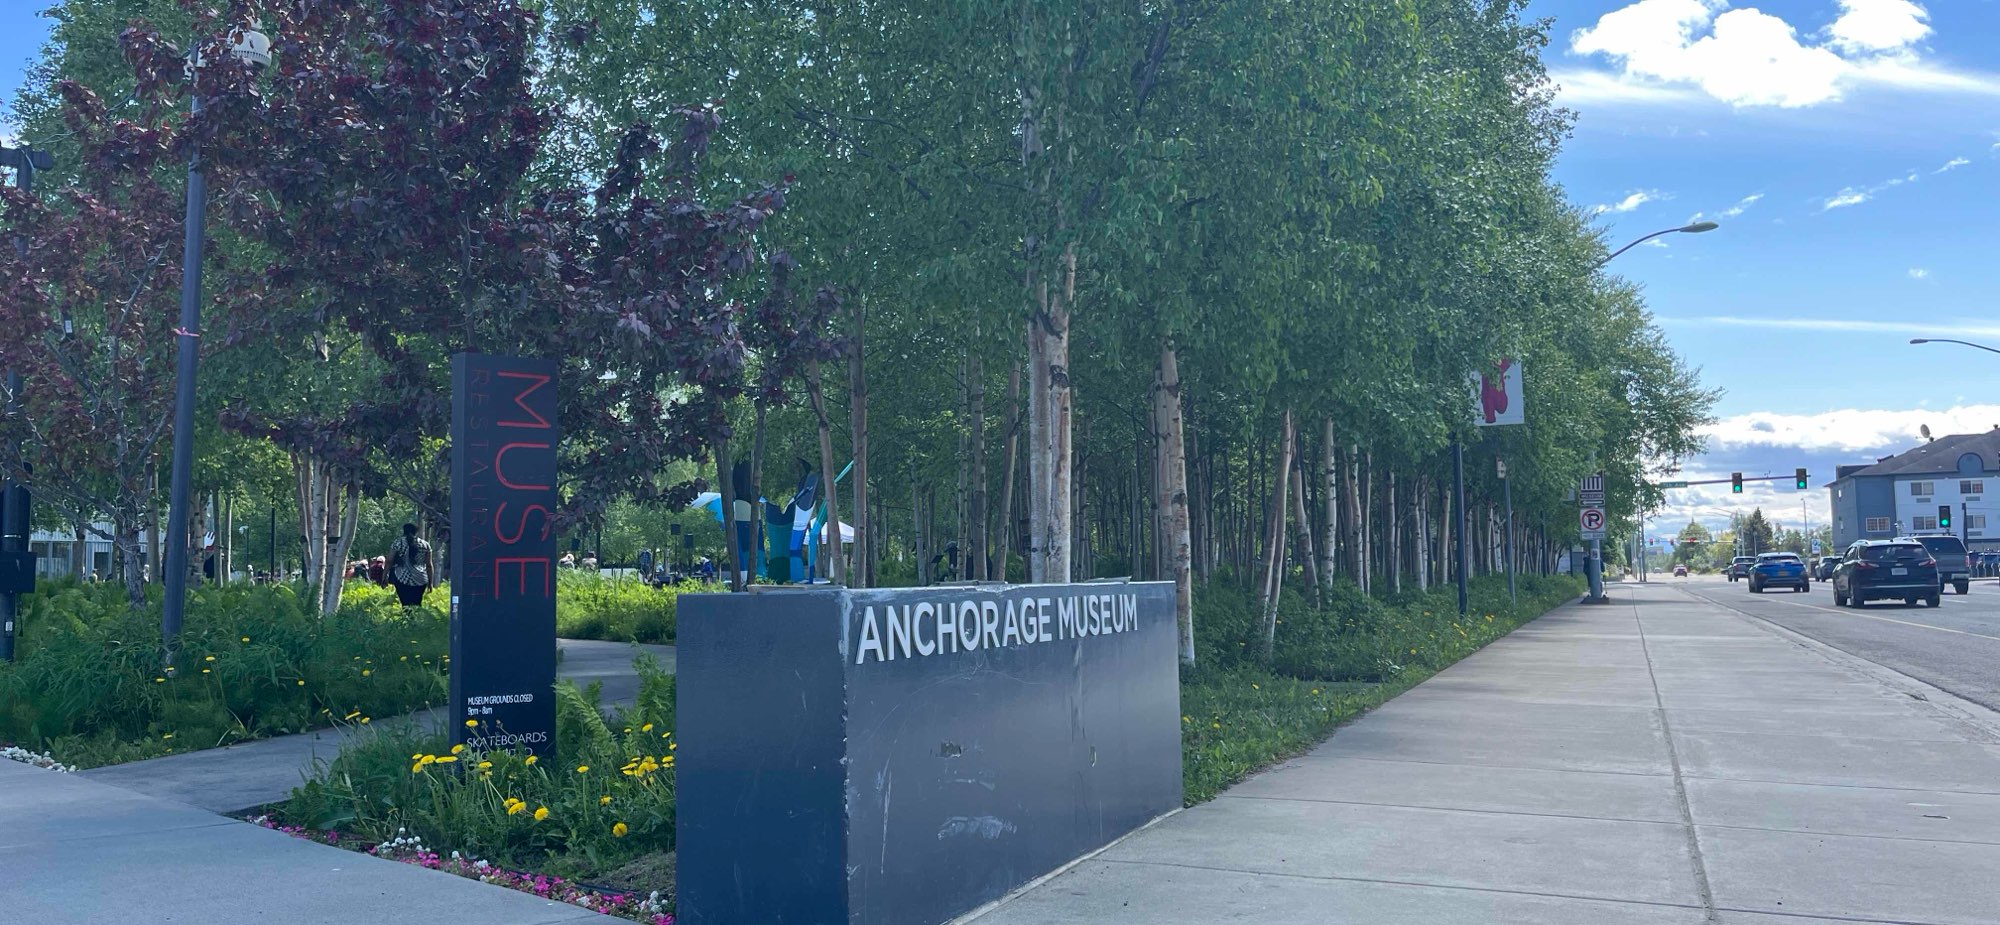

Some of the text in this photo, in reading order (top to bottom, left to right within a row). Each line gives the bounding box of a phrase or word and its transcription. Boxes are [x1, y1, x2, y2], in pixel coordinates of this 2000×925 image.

[468, 369, 489, 602] RESTAURANT
[495, 371, 551, 600] MUSE
[855, 593, 1138, 665] ANCHORAGE MUSEUM
[467, 693, 534, 706] MUSEUM GROUNDS CLOSED
[467, 706, 479, 716] 9pm
[481, 706, 493, 715] 8am
[466, 732, 547, 748] SKATEBOARDS
